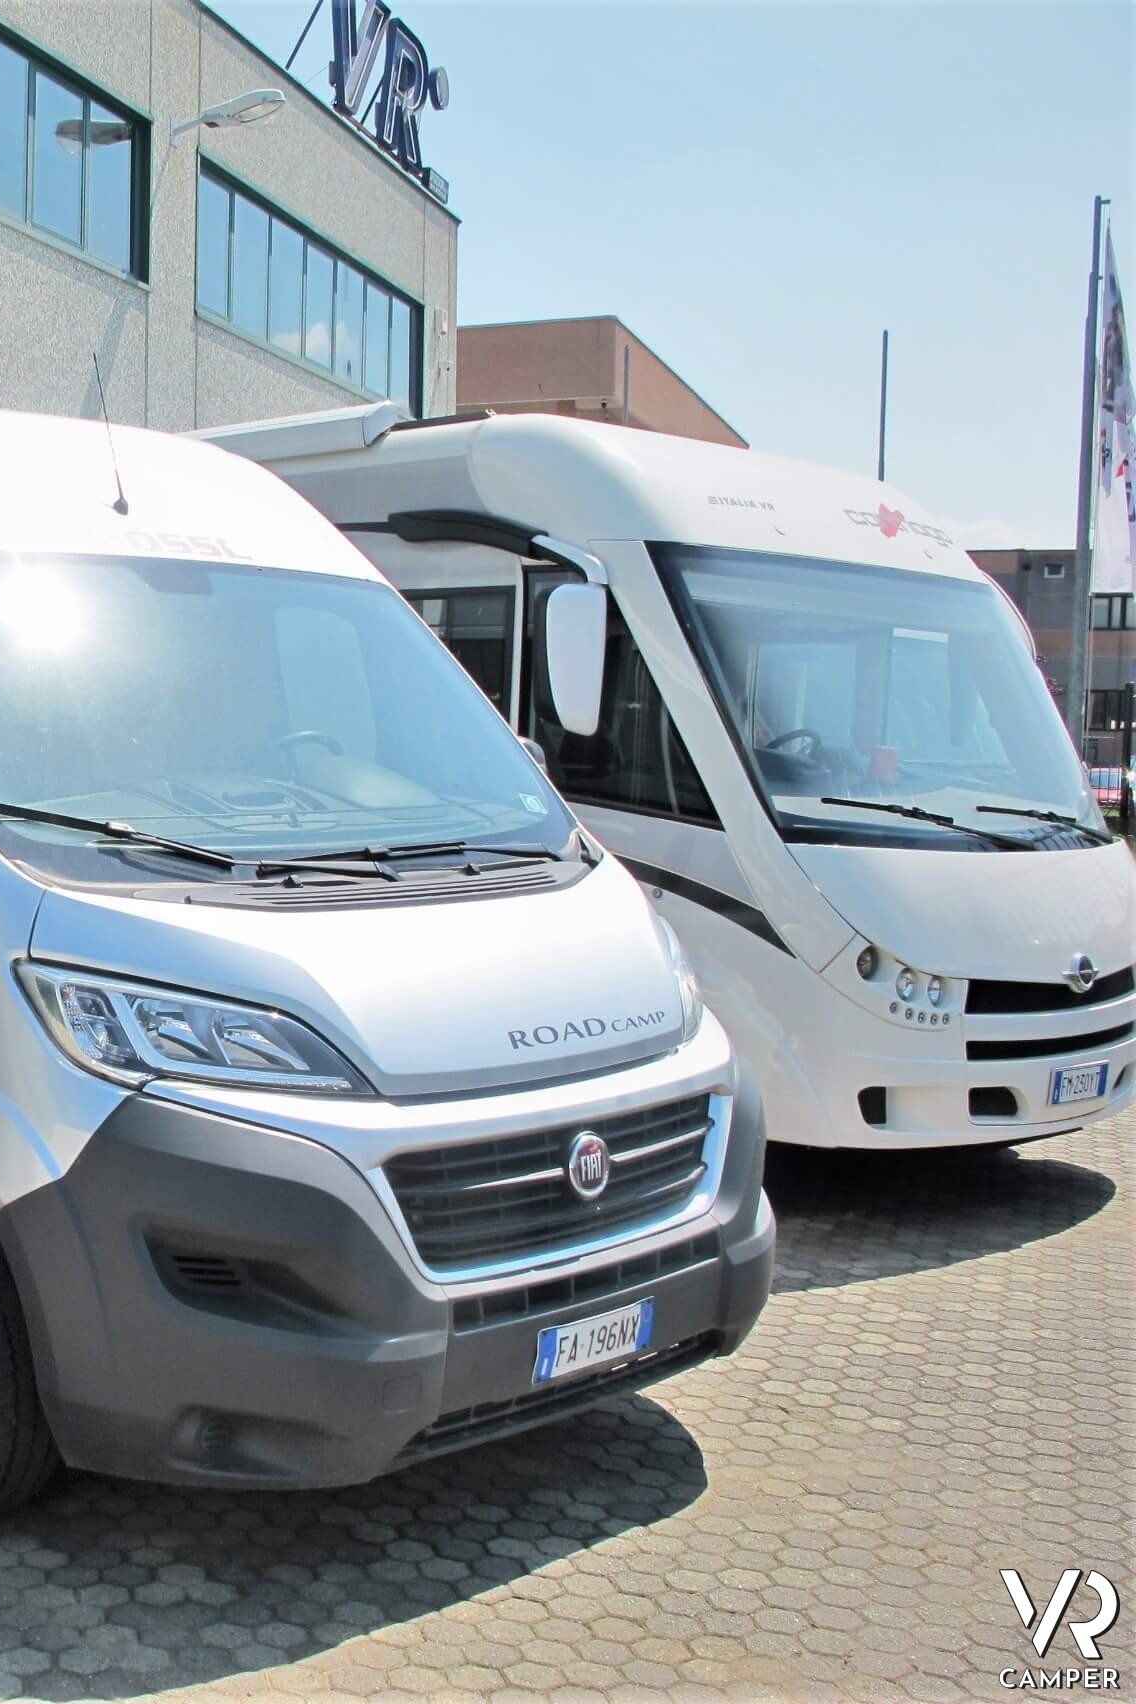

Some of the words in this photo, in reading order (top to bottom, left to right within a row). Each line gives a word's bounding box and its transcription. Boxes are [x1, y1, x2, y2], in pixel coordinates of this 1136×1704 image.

[507, 1018, 607, 1050] ROAD
[610, 1010, 665, 1032] CAMP
[580, 1149, 602, 1182] FIAT
